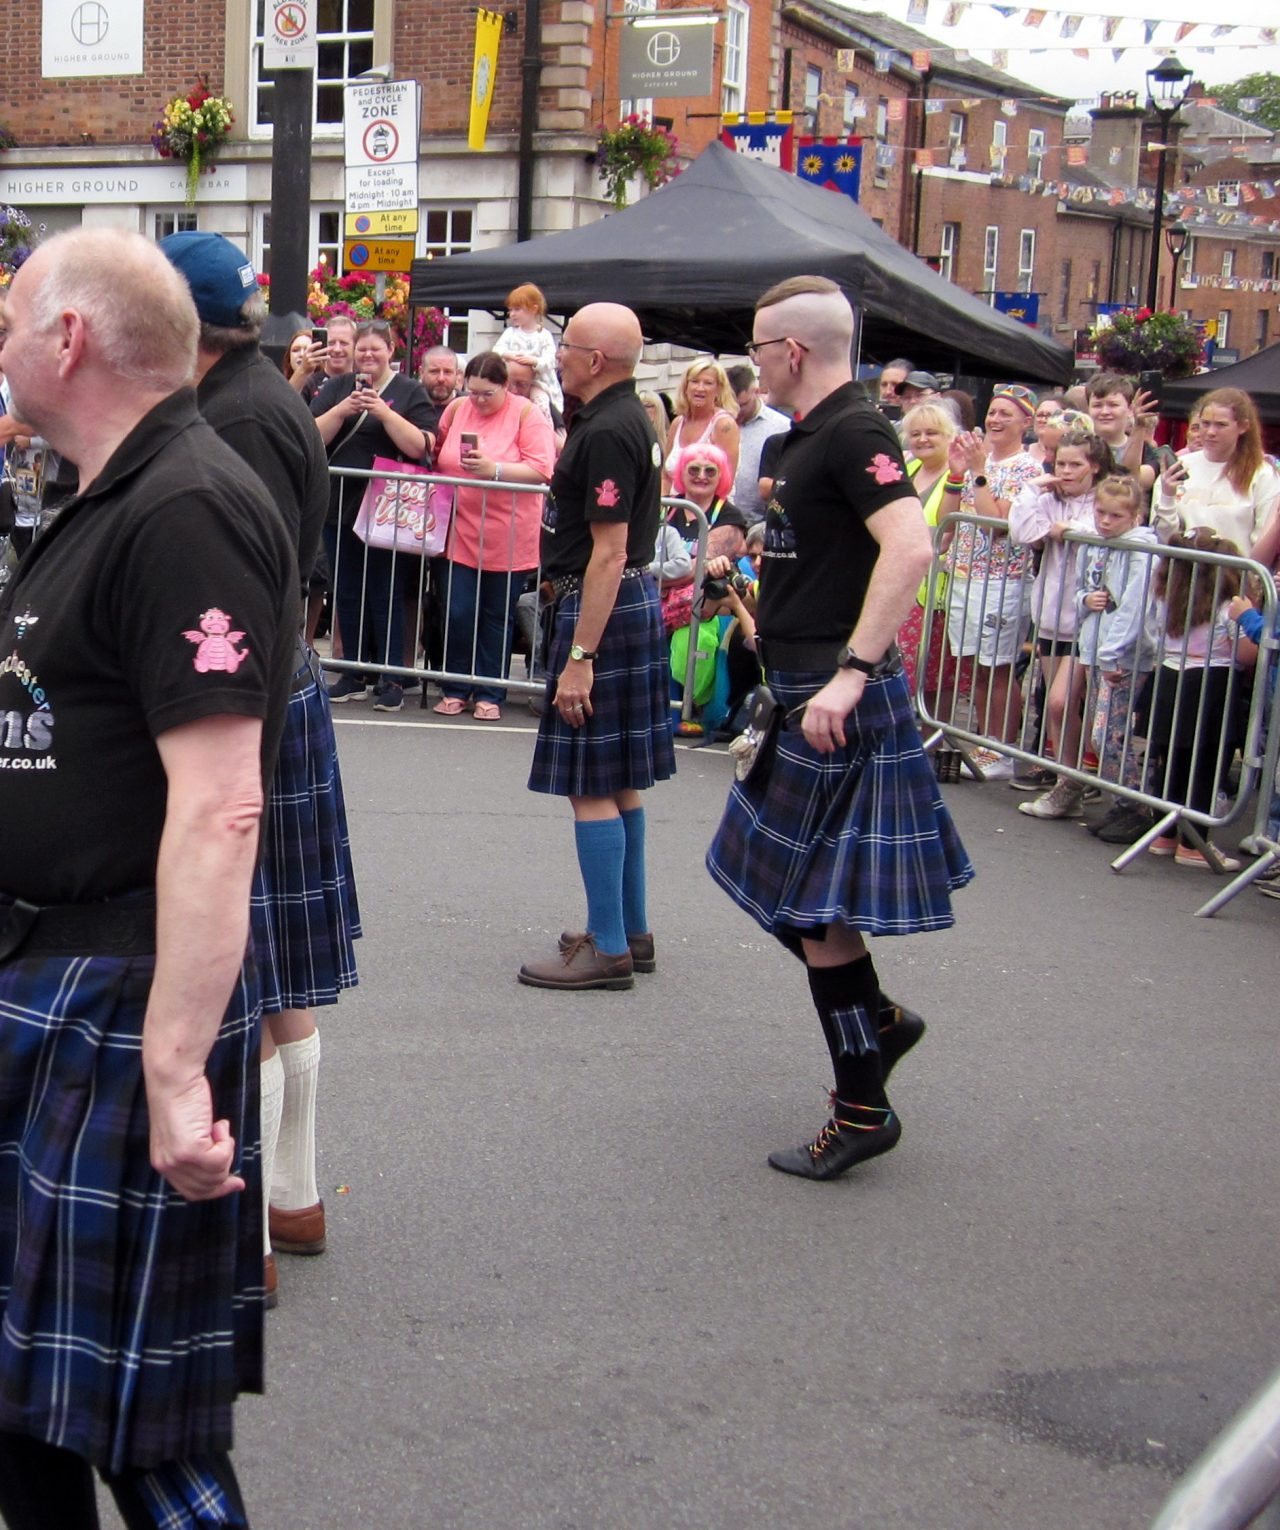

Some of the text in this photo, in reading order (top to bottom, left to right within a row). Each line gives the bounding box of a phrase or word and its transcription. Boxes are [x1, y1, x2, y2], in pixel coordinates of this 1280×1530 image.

[54, 53, 130, 63] HIGHER GROUND
[632, 70, 698, 79] HIGHER GROUND
[352, 84, 407, 97] PEDESTRIAN
[358, 94, 402, 106] and CYCLE
[362, 105, 398, 118] ZONE
[367, 168, 395, 177] Except
[8, 181, 64, 193] HIGHER
[72, 180, 138, 192] GROUND
[359, 177, 403, 187] for loading
[349, 191, 384, 200] Midnight
[391, 189, 400, 197] 10
[376, 199, 412, 209] Midnight
[380, 214, 407, 222] At any
[385, 224, 403, 232] time
[374, 247, 400, 256] At any
[378, 256, 396, 265] time
